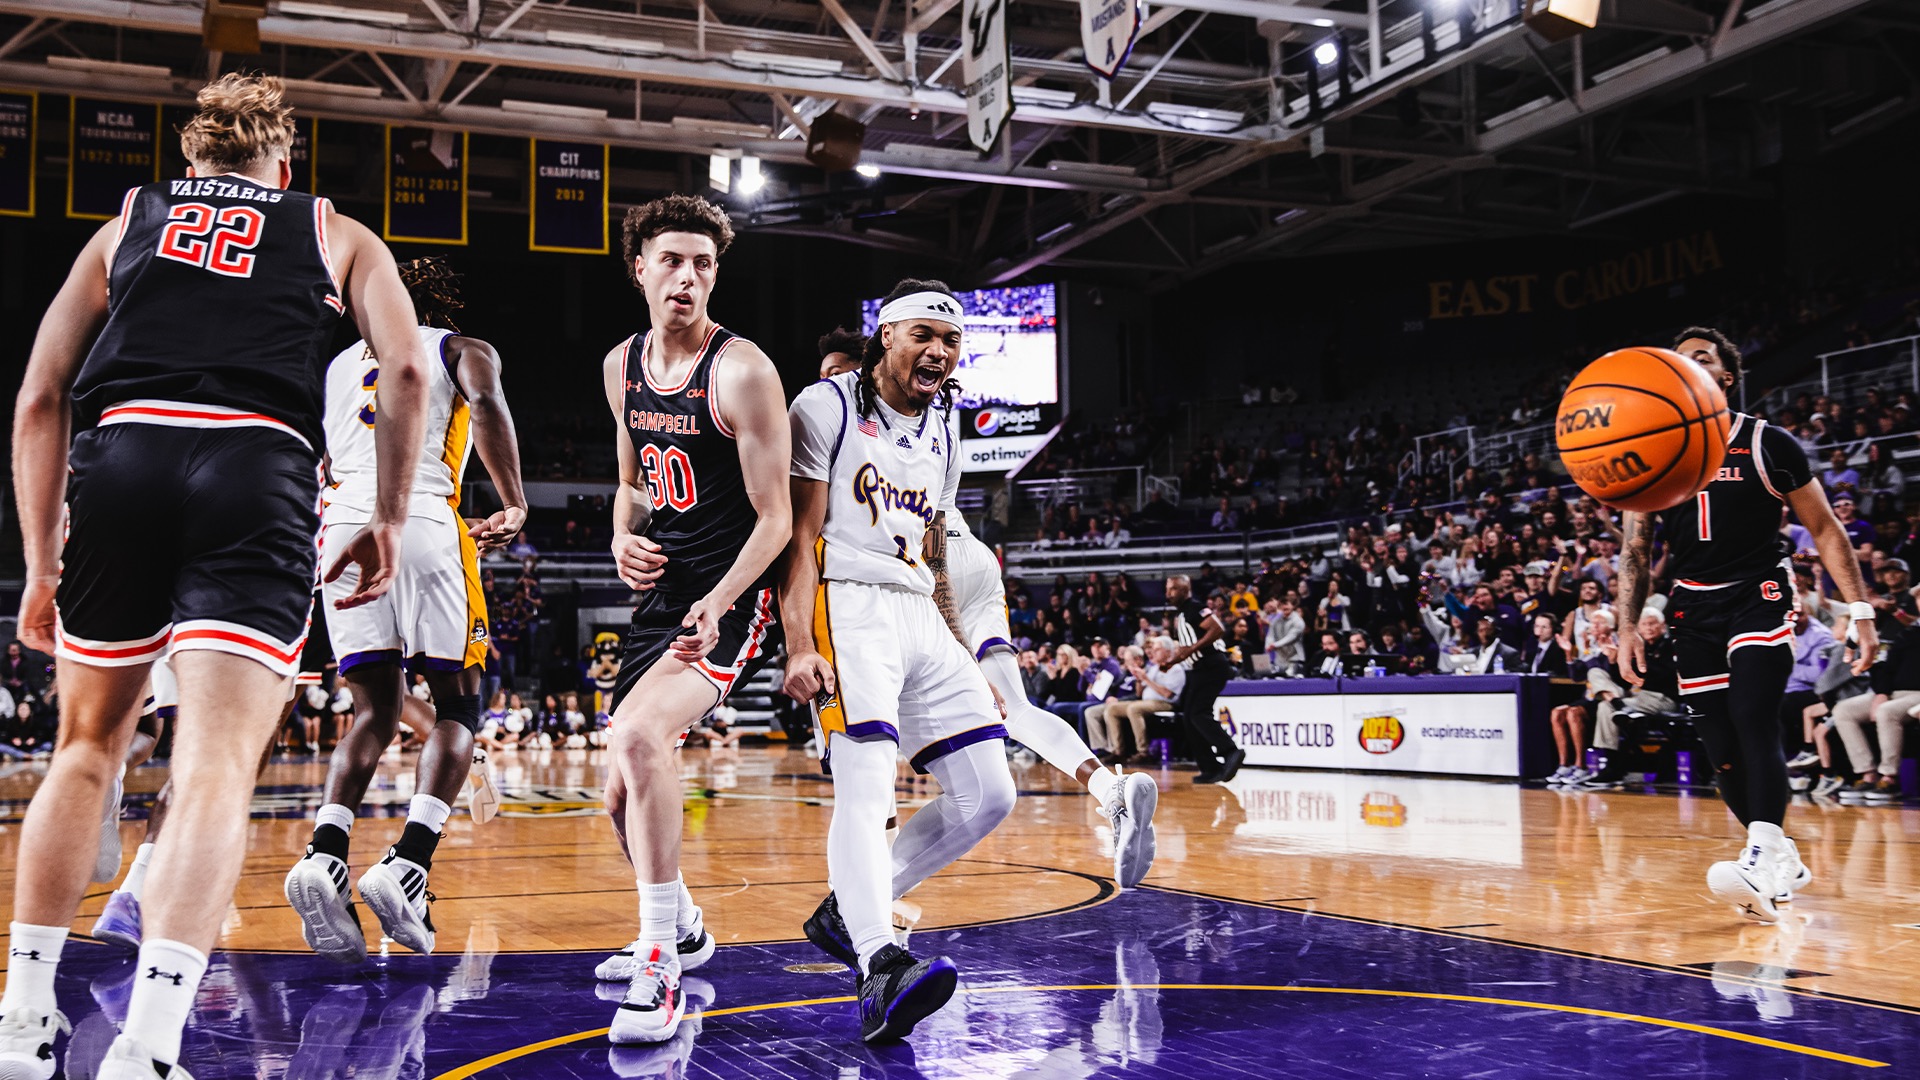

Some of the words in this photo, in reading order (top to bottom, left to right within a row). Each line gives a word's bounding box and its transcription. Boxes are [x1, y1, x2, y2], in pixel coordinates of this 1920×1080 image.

[97, 111, 135, 127] NCAA
[560, 152, 579, 166] CIT
[394, 176, 424, 189] 2011
[540, 166, 601, 181] CHAMPIONS
[170, 179, 284, 203] VAIŠTARAS
[394, 190, 425, 205] 2014
[156, 202, 266, 278] 22
[1428, 275, 1539, 320] EAST
[1554, 230, 1724, 311] CAROLINA
[629, 409, 701, 435] CAMPBELL
[999, 407, 1041, 428] pepsi
[971, 446, 1031, 464] optimu
[640, 443, 698, 513] 30
[1709, 467, 1744, 483] ELL
[1697, 490, 1711, 541] 1
[1759, 580, 1783, 602] C
[1241, 722, 1289, 746] PIRATE
[1295, 723, 1334, 748] CLUB
[1420, 724, 1504, 741] ecupirates.com
